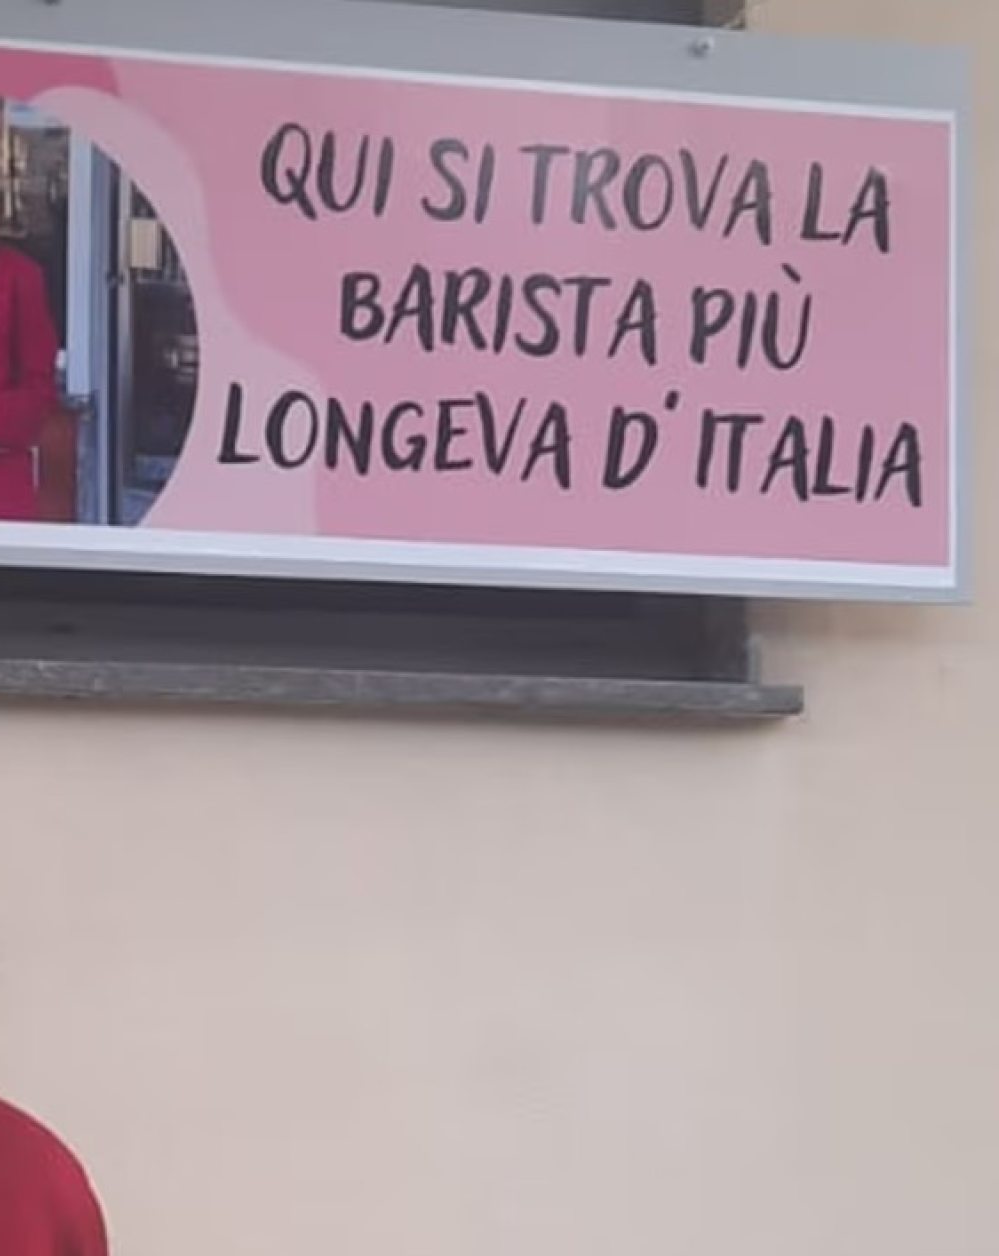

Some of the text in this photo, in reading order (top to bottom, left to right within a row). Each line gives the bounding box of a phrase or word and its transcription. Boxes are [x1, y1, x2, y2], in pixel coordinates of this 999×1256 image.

[260, 122, 890, 253] QUI SI TROVA LA
[339, 263, 812, 370] BARISTA PIÙ
[217, 381, 571, 490] LONGEVA
[696, 408, 922, 508] ITALIA
